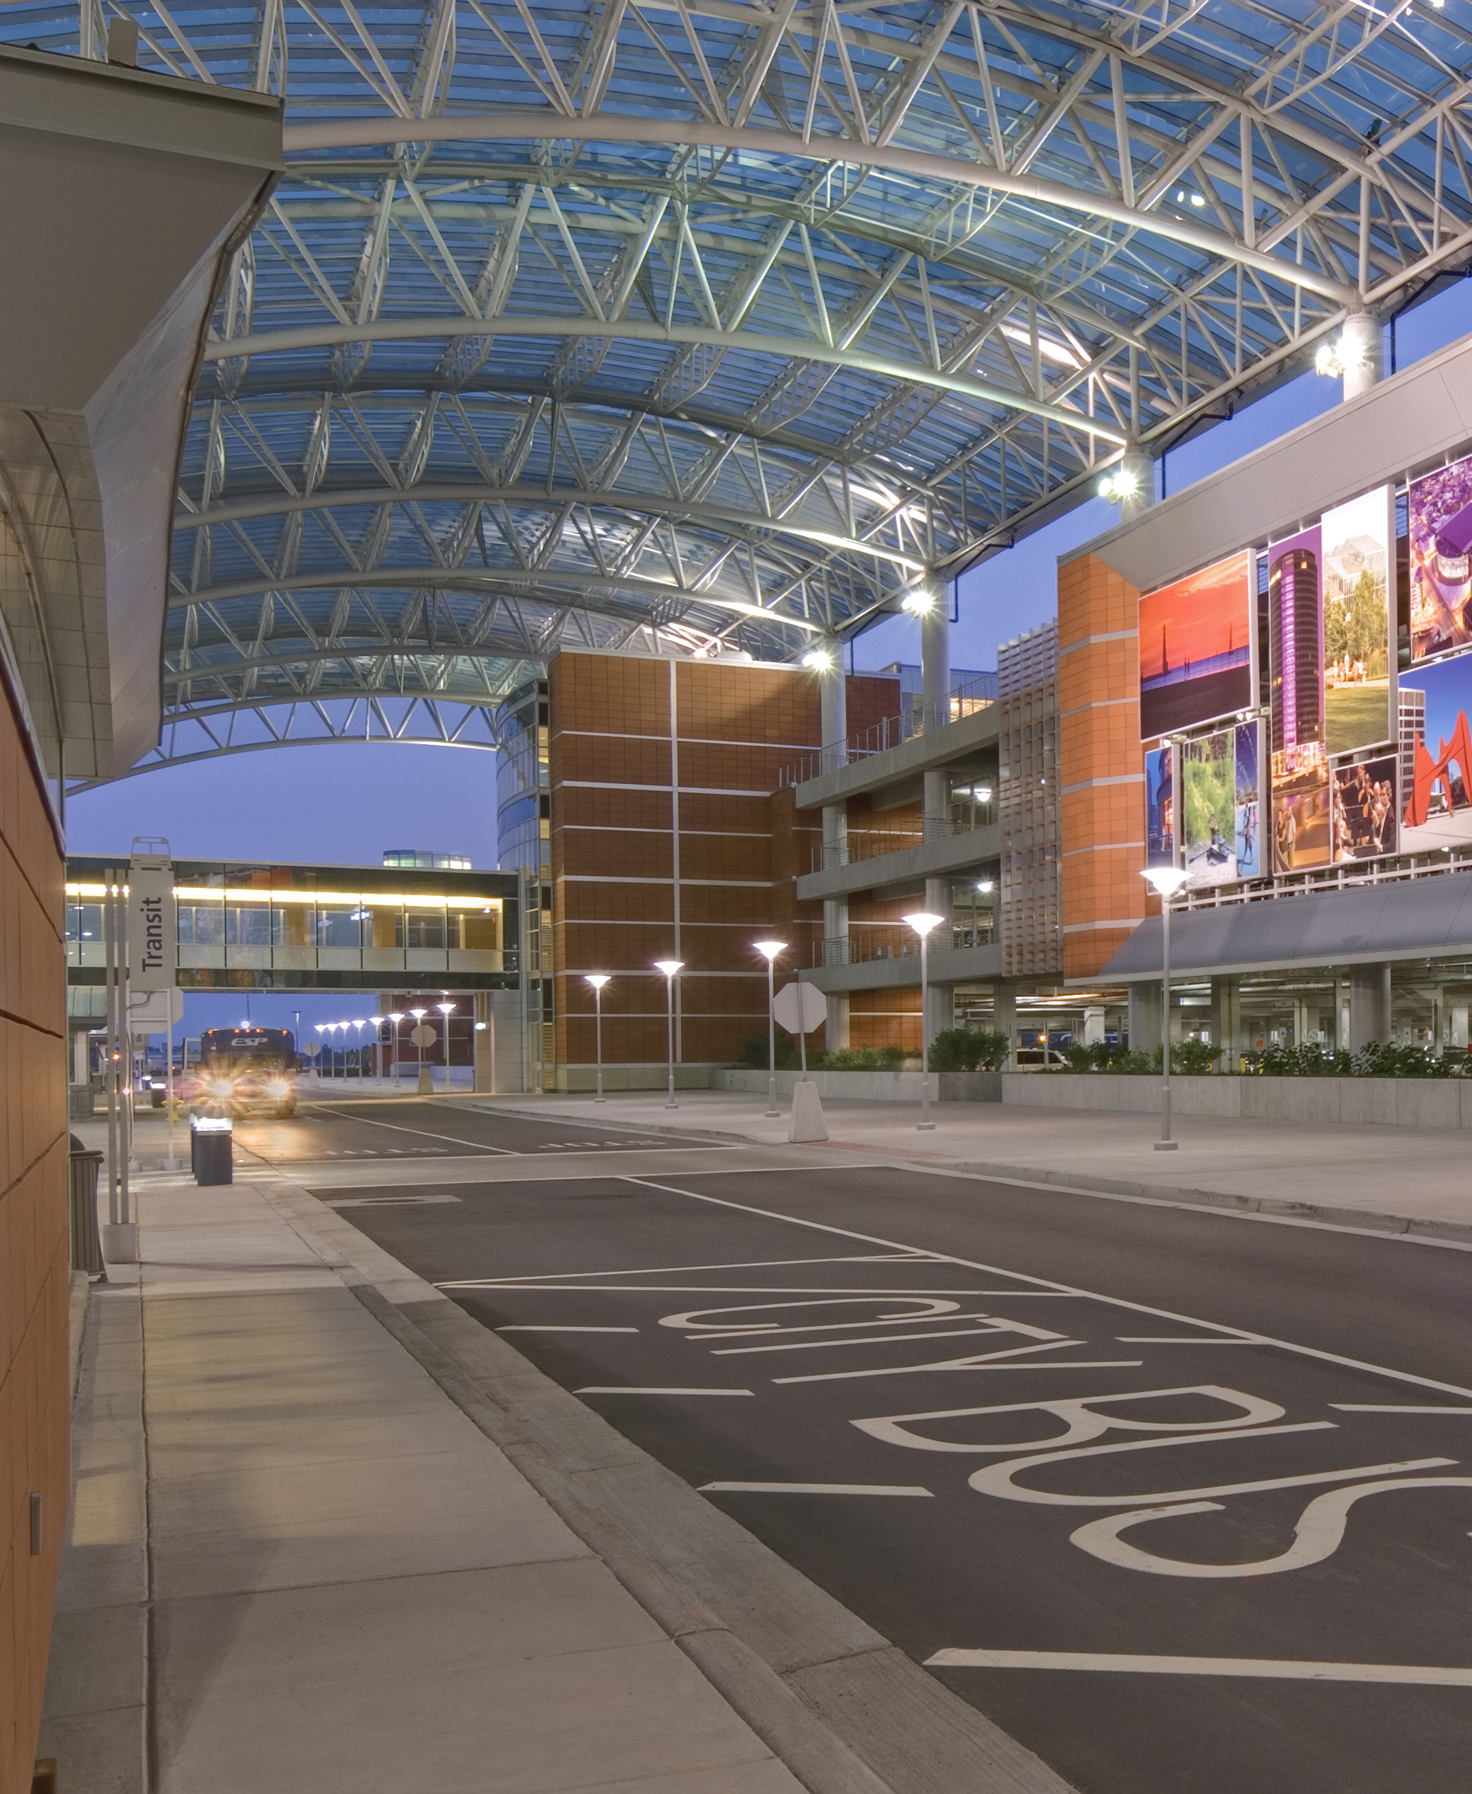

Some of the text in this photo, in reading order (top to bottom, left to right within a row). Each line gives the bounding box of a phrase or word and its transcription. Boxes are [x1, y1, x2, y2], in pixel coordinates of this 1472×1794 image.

[140, 897, 163, 972] Transit
[231, 1037, 268, 1046] ESP
[657, 1297, 1143, 1384] CITY
